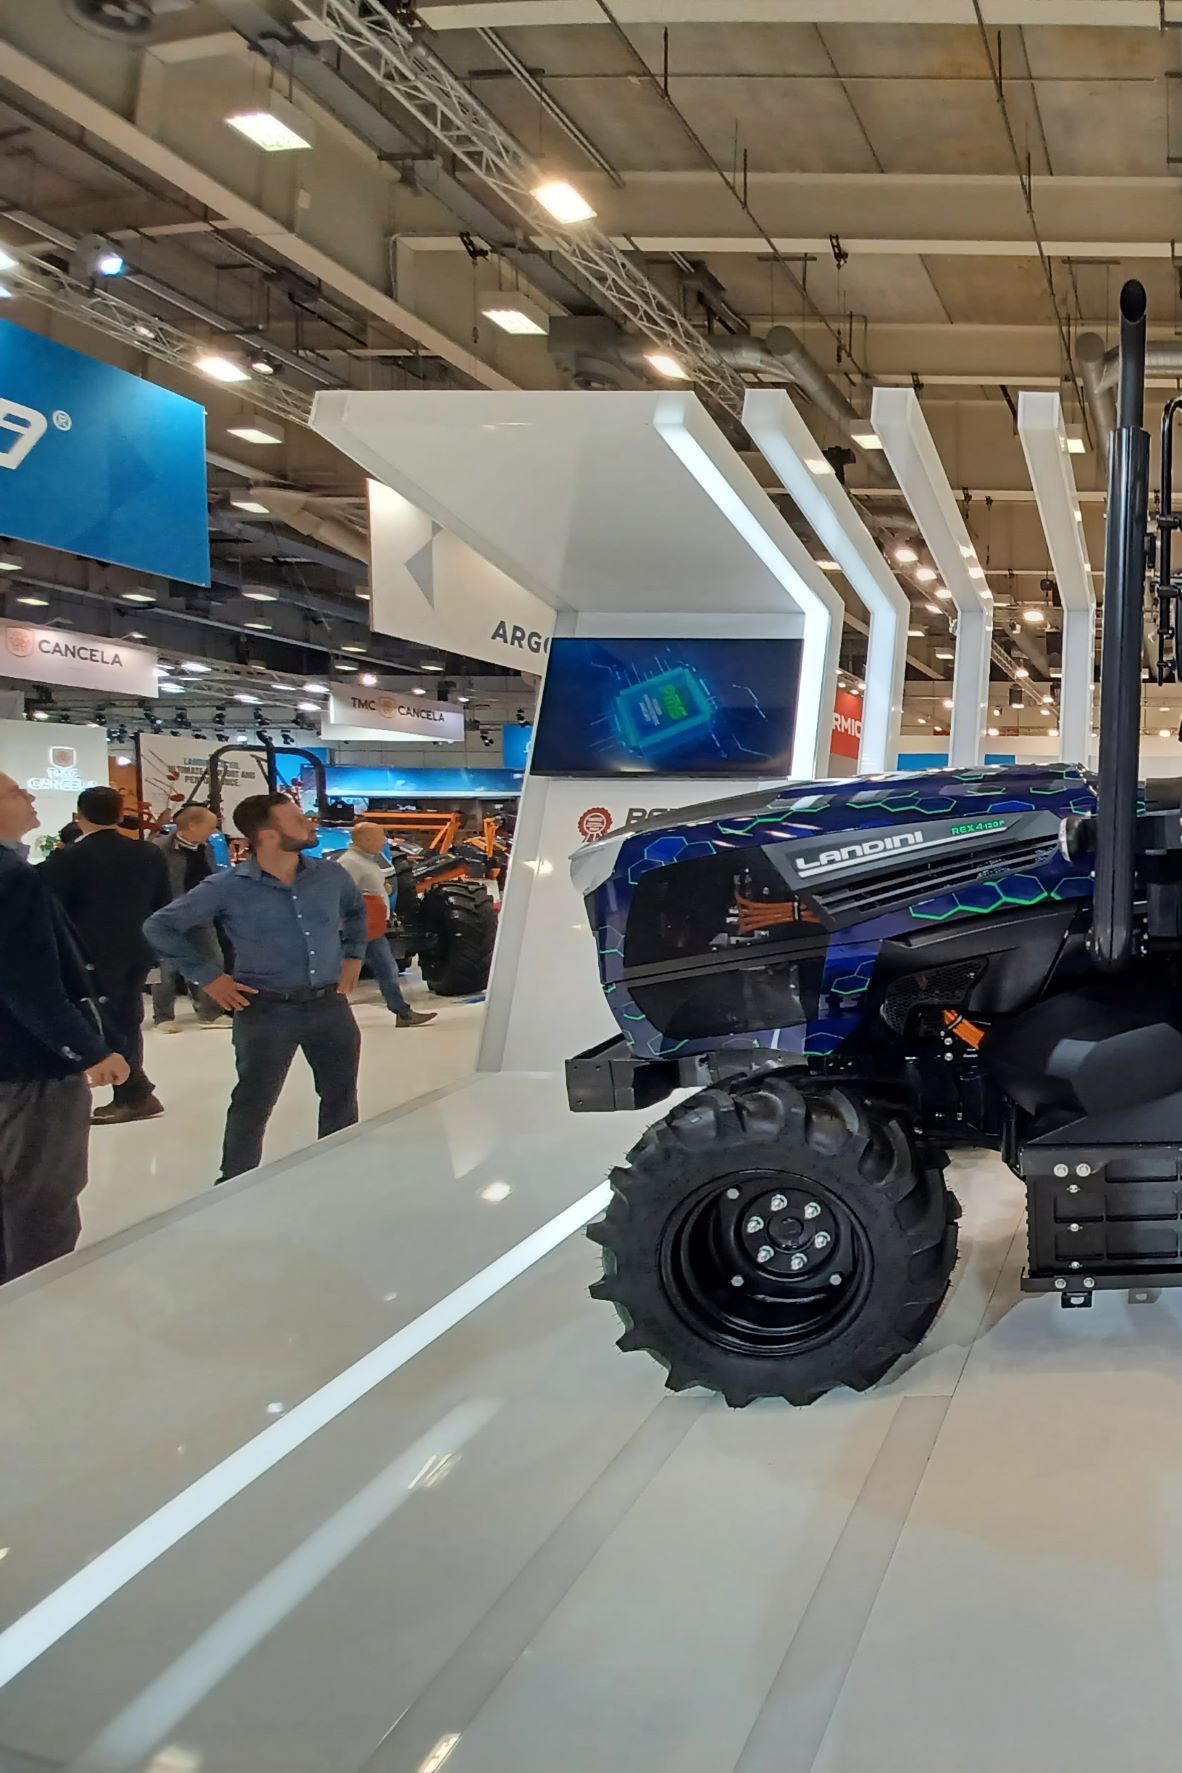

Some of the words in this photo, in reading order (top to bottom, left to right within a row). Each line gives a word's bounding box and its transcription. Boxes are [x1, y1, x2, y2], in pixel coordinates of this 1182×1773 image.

[38, 639, 123, 667] CANCELA
[351, 697, 376, 711] TMC
[397, 705, 445, 722] CANCELA
[795, 830, 924, 870] LANDINI
